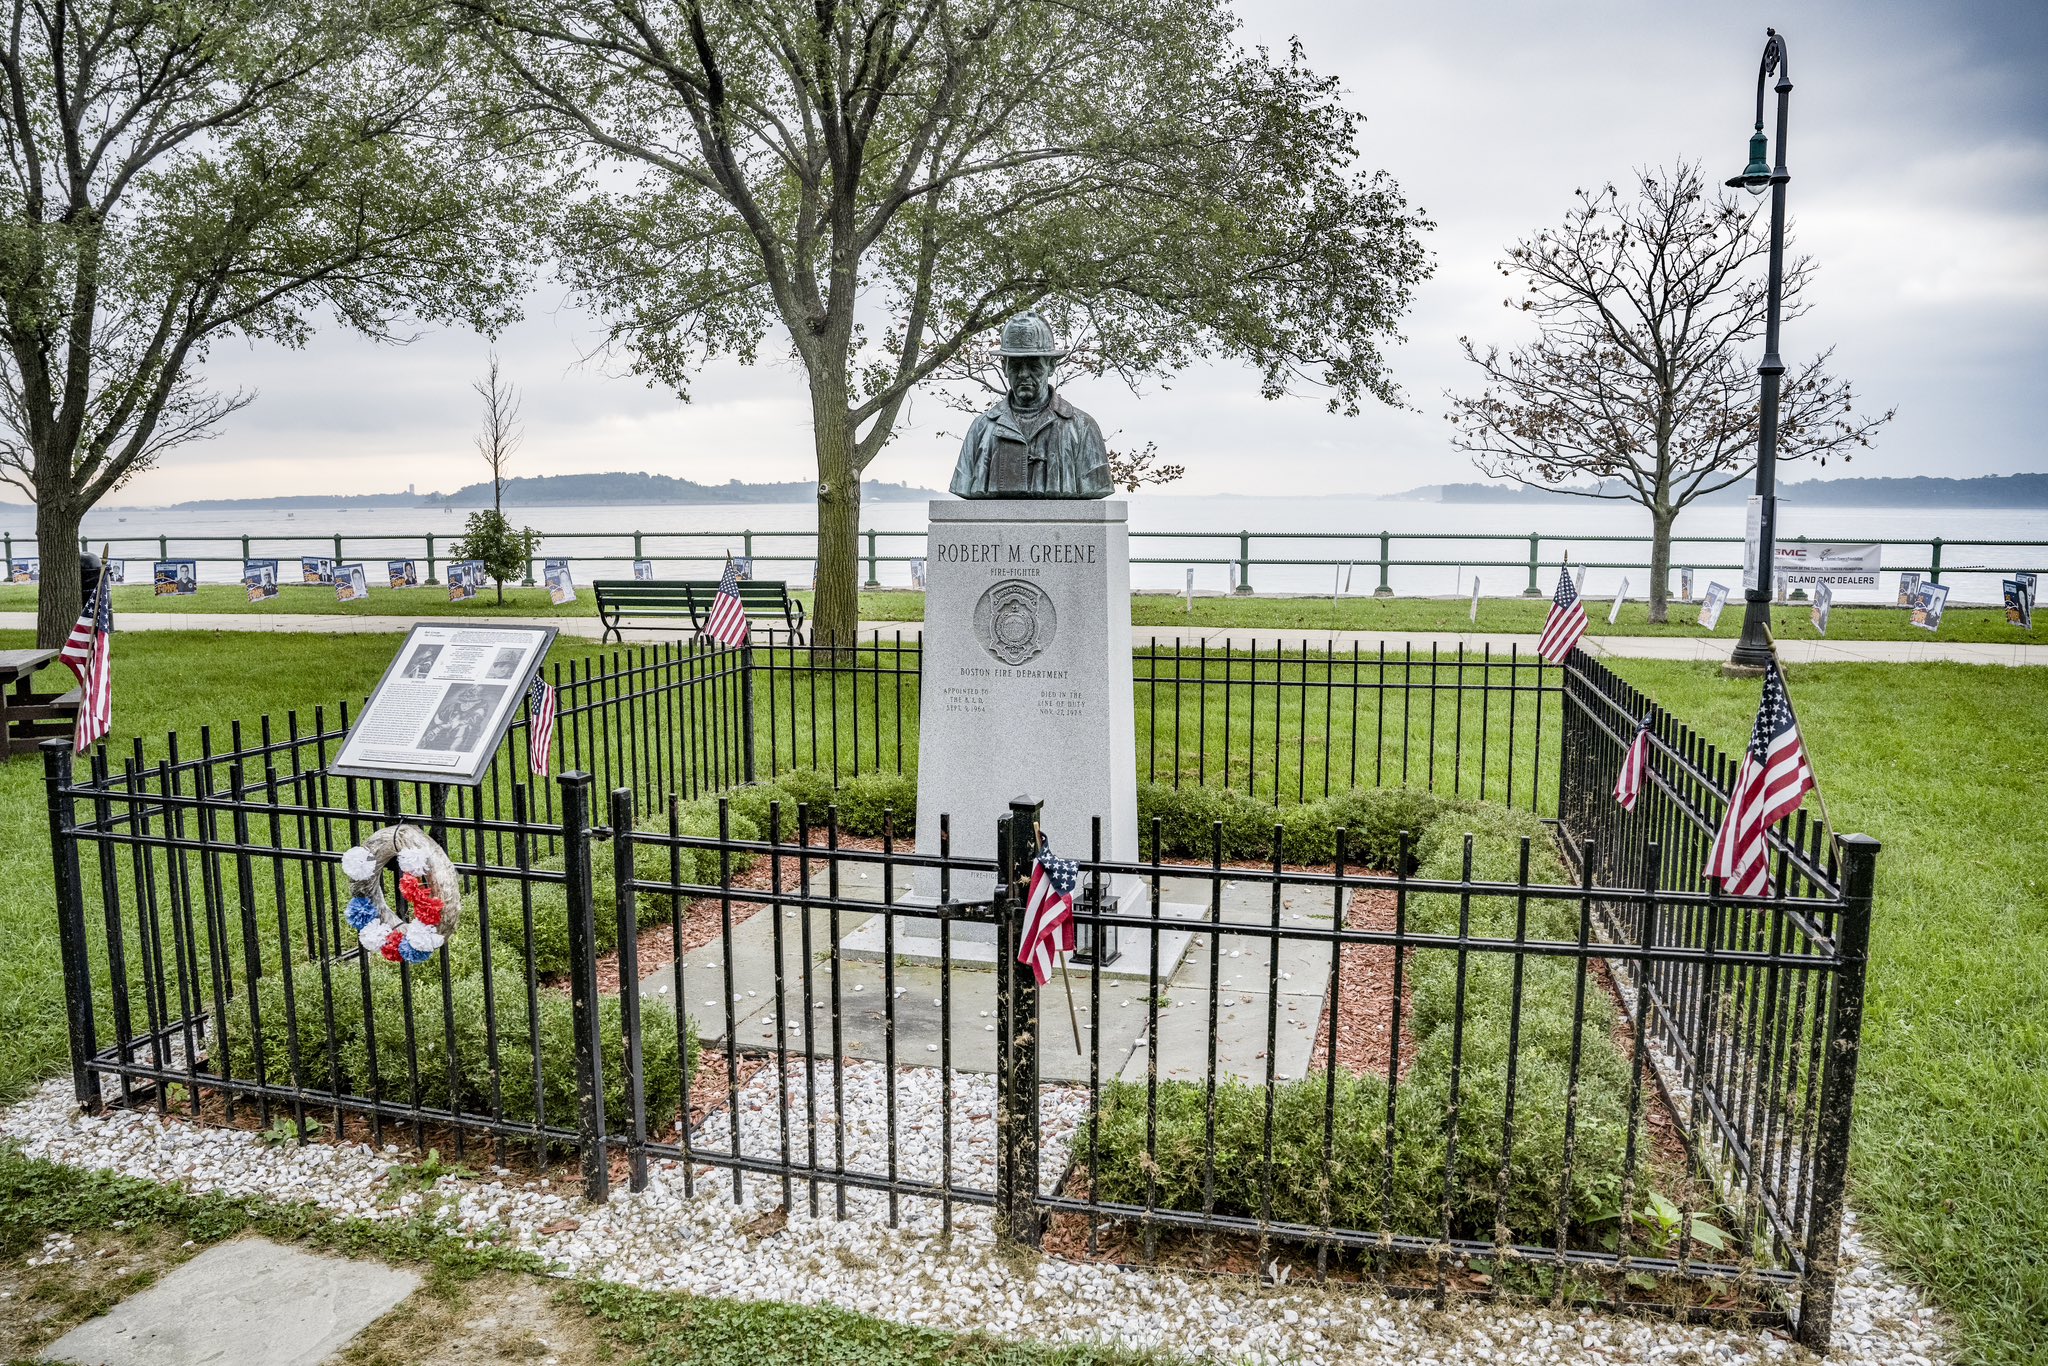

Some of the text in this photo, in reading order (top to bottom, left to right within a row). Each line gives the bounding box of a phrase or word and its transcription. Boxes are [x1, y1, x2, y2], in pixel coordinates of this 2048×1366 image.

[938, 544, 1096, 564] ROBERT M. GREENE
[990, 568, 1040, 577] FIRE-FIGHTER
[1788, 575, 1816, 584] GLAND
[1837, 576, 1875, 585] DEALERS
[960, 668, 1068, 679] BOSTON FIRE DEPARTMENT
[943, 687, 979, 695] APPOINTED
[1067, 700, 1085, 708] DUTY
